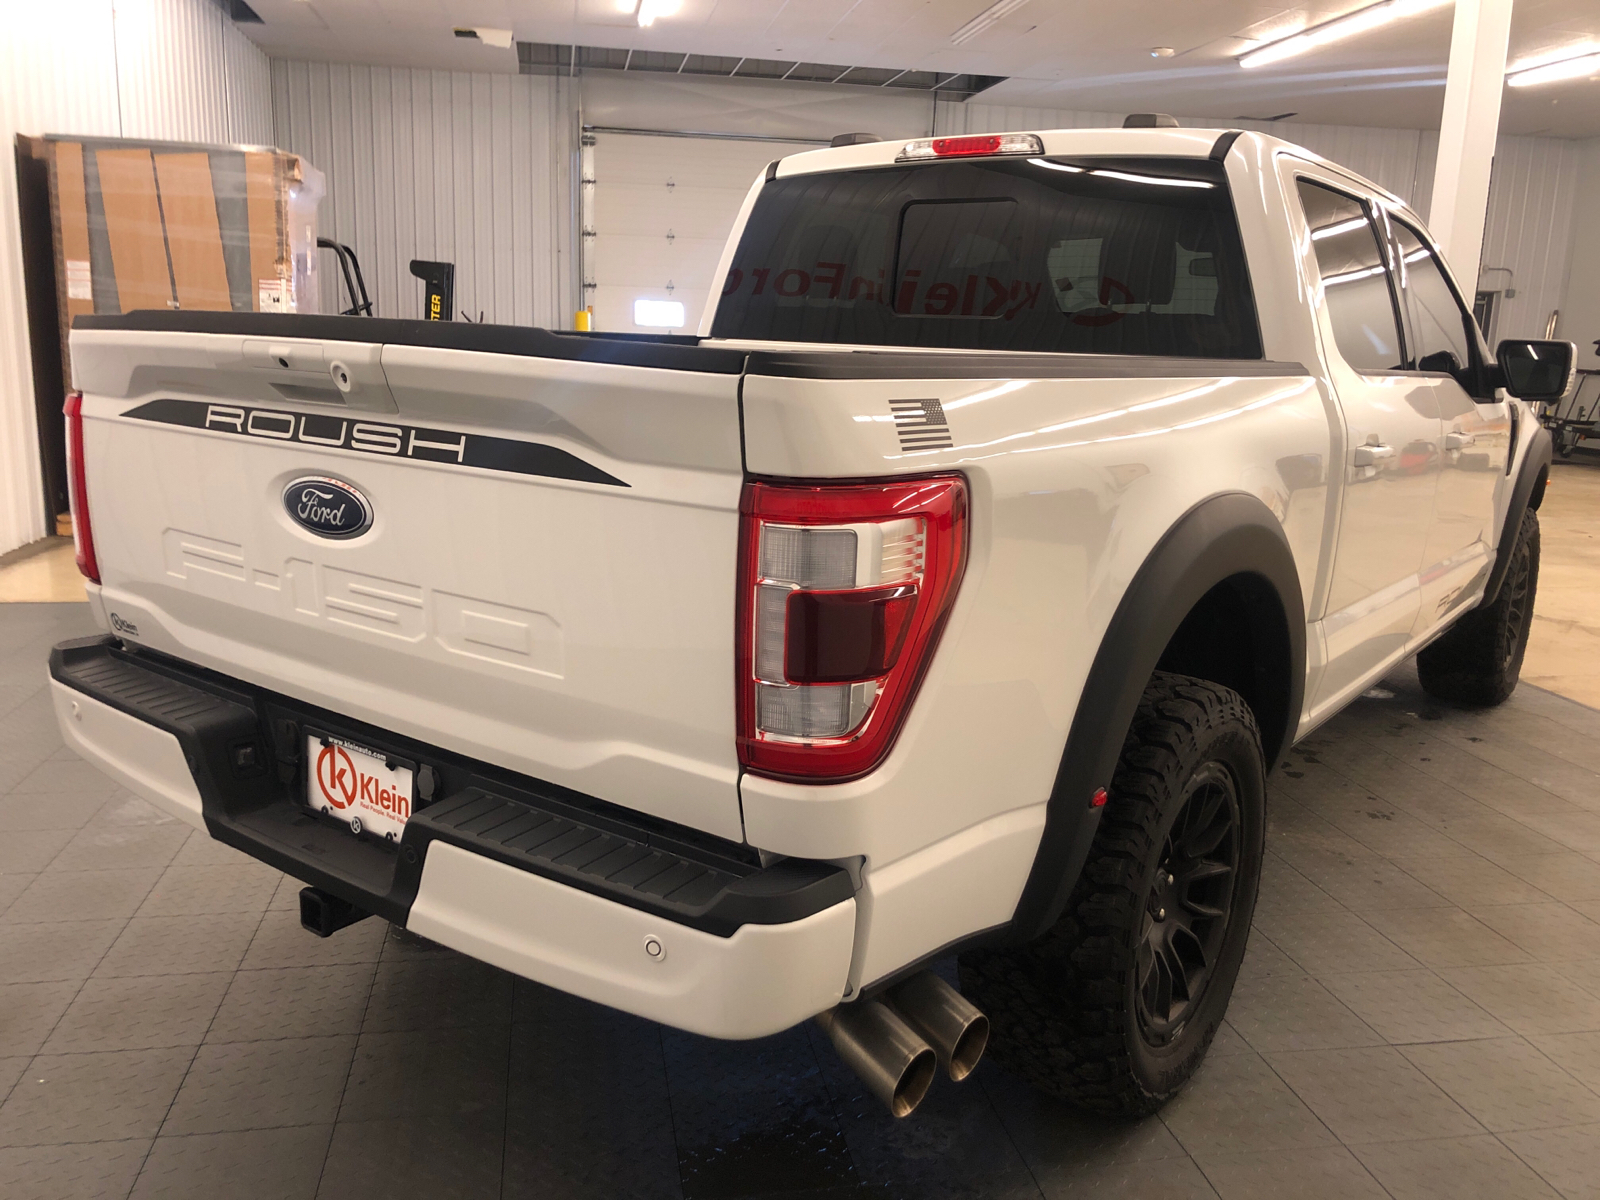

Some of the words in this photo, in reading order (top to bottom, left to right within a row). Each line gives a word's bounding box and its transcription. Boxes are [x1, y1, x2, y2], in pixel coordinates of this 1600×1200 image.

[431, 294, 441, 321] TER
[205, 404, 467, 463] ROUSH
[297, 488, 346, 526] Ford
[162, 527, 564, 680] F-150
[328, 736, 387, 761] www.kleinauto.com
[360, 772, 410, 818] Klein
